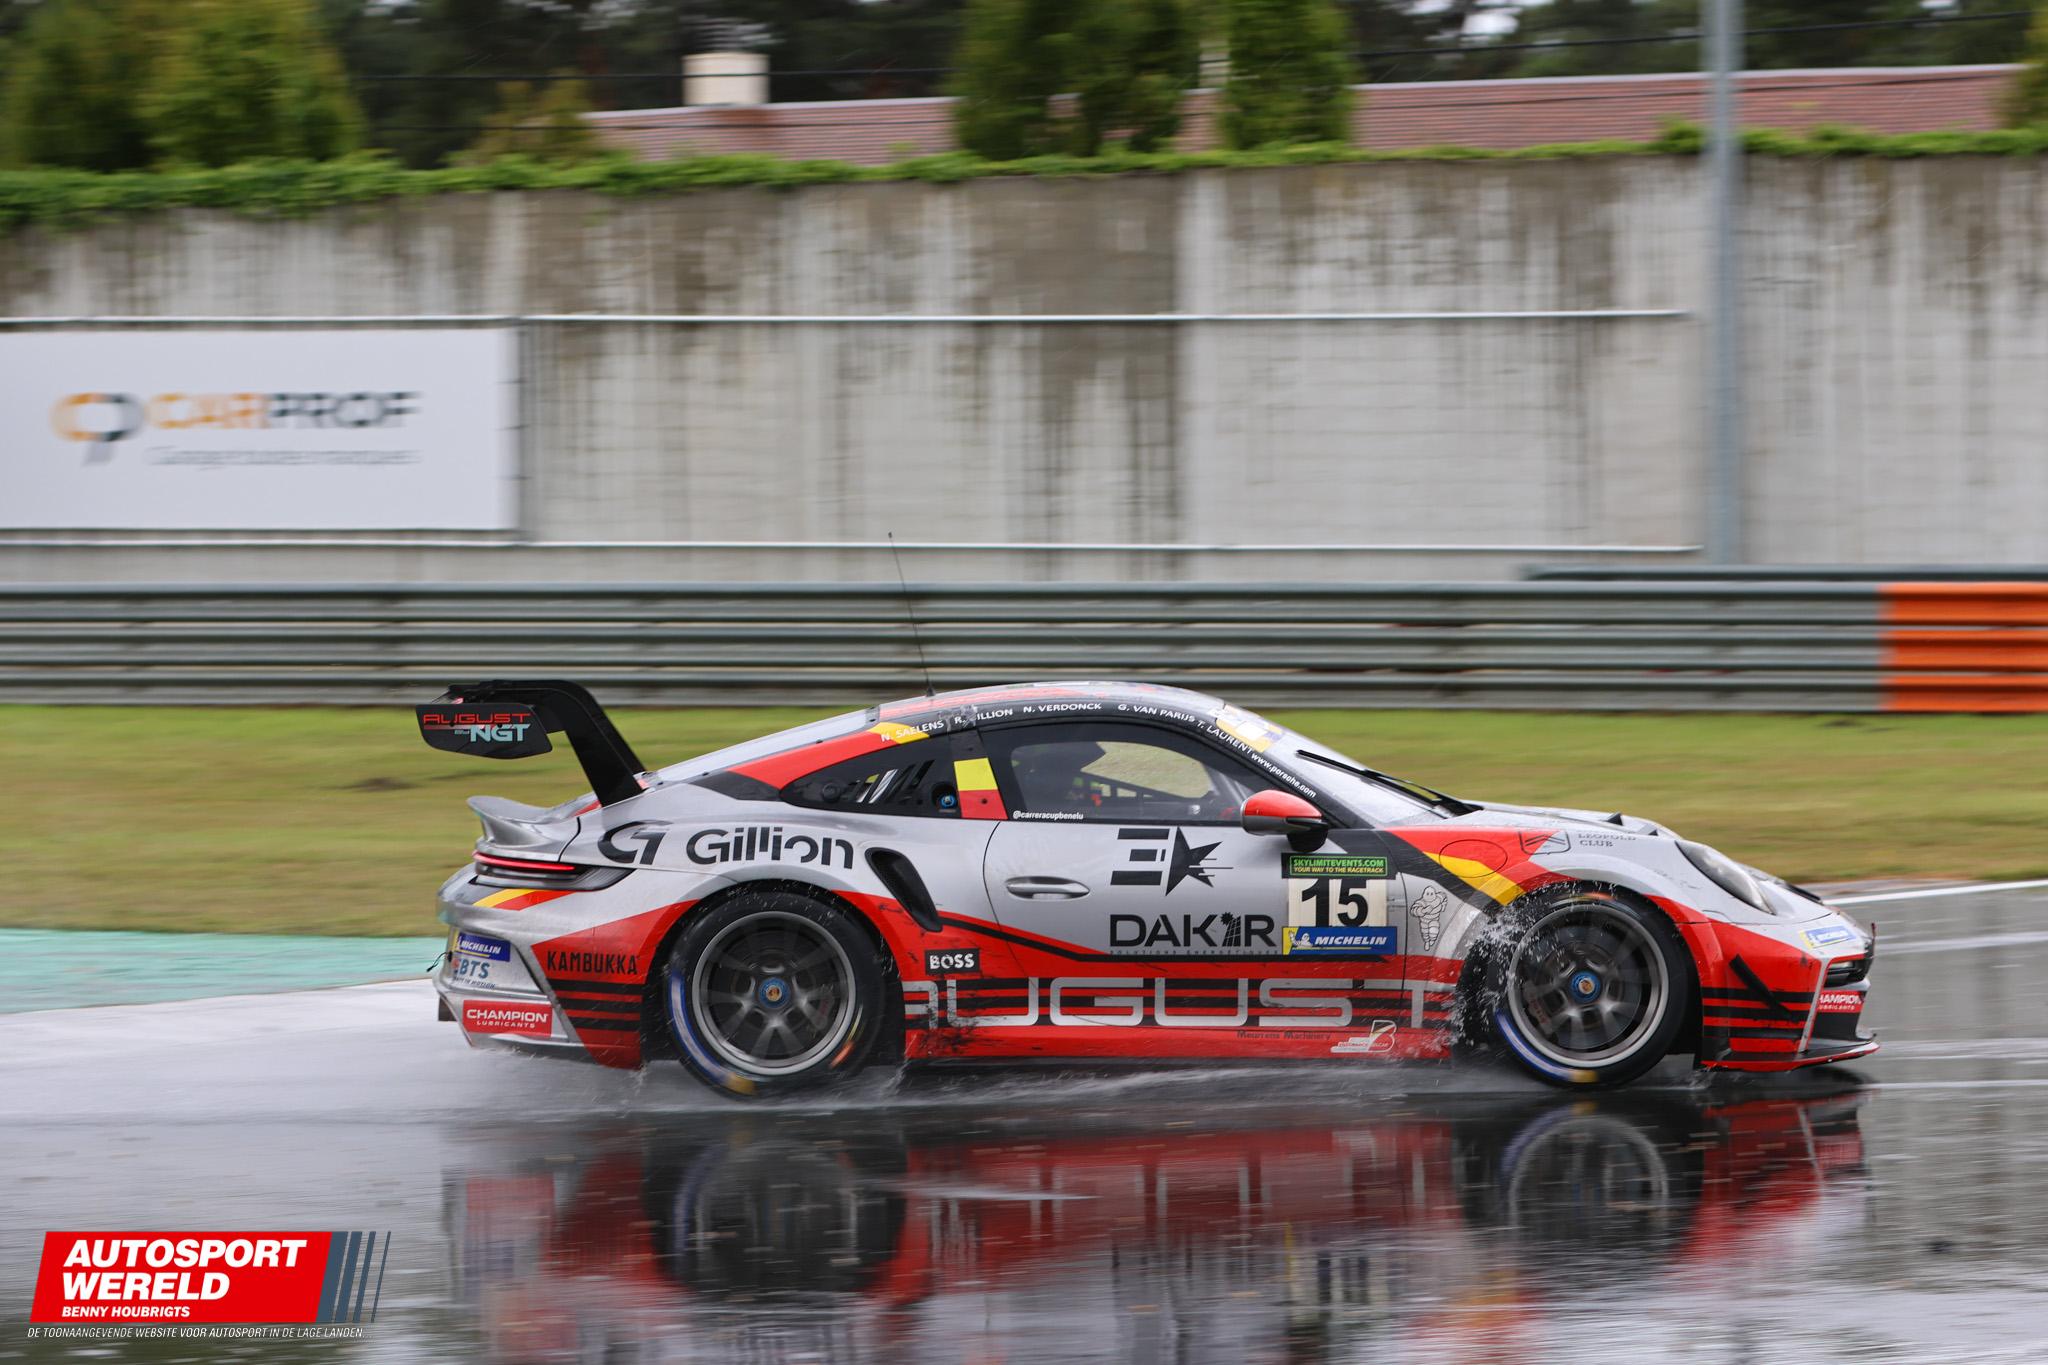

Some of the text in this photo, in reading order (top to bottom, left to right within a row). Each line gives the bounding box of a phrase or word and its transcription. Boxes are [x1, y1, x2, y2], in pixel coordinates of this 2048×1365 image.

[976, 708, 1013, 721] ILLION
[1038, 703, 1102, 713] VERDONCK
[1133, 705, 1157, 715] VAN
[1159, 709, 1196, 723] PARIJS
[423, 713, 531, 724] AUGUST
[470, 724, 531, 742] NGT
[896, 720, 944, 739] SAELENS
[1206, 725, 1253, 755] LAURENT
[1251, 753, 1317, 798] www.porsche.com
[1013, 810, 1084, 820] @carreracupbenelu
[686, 826, 854, 869] Gillion
[1293, 859, 1384, 867] SKYLIMITEVENTS.COM
[1302, 878, 1369, 927] 15
[461, 940, 502, 954] MICHELIN
[1315, 936, 1388, 945] MICHELIN
[547, 951, 638, 975] KAMBUKKA
[929, 953, 975, 970] BOSS
[1820, 994, 1862, 1004] AMPION
[466, 1009, 548, 1022] CHAMPION
[476, 1020, 536, 1029] LUBRICANTS
